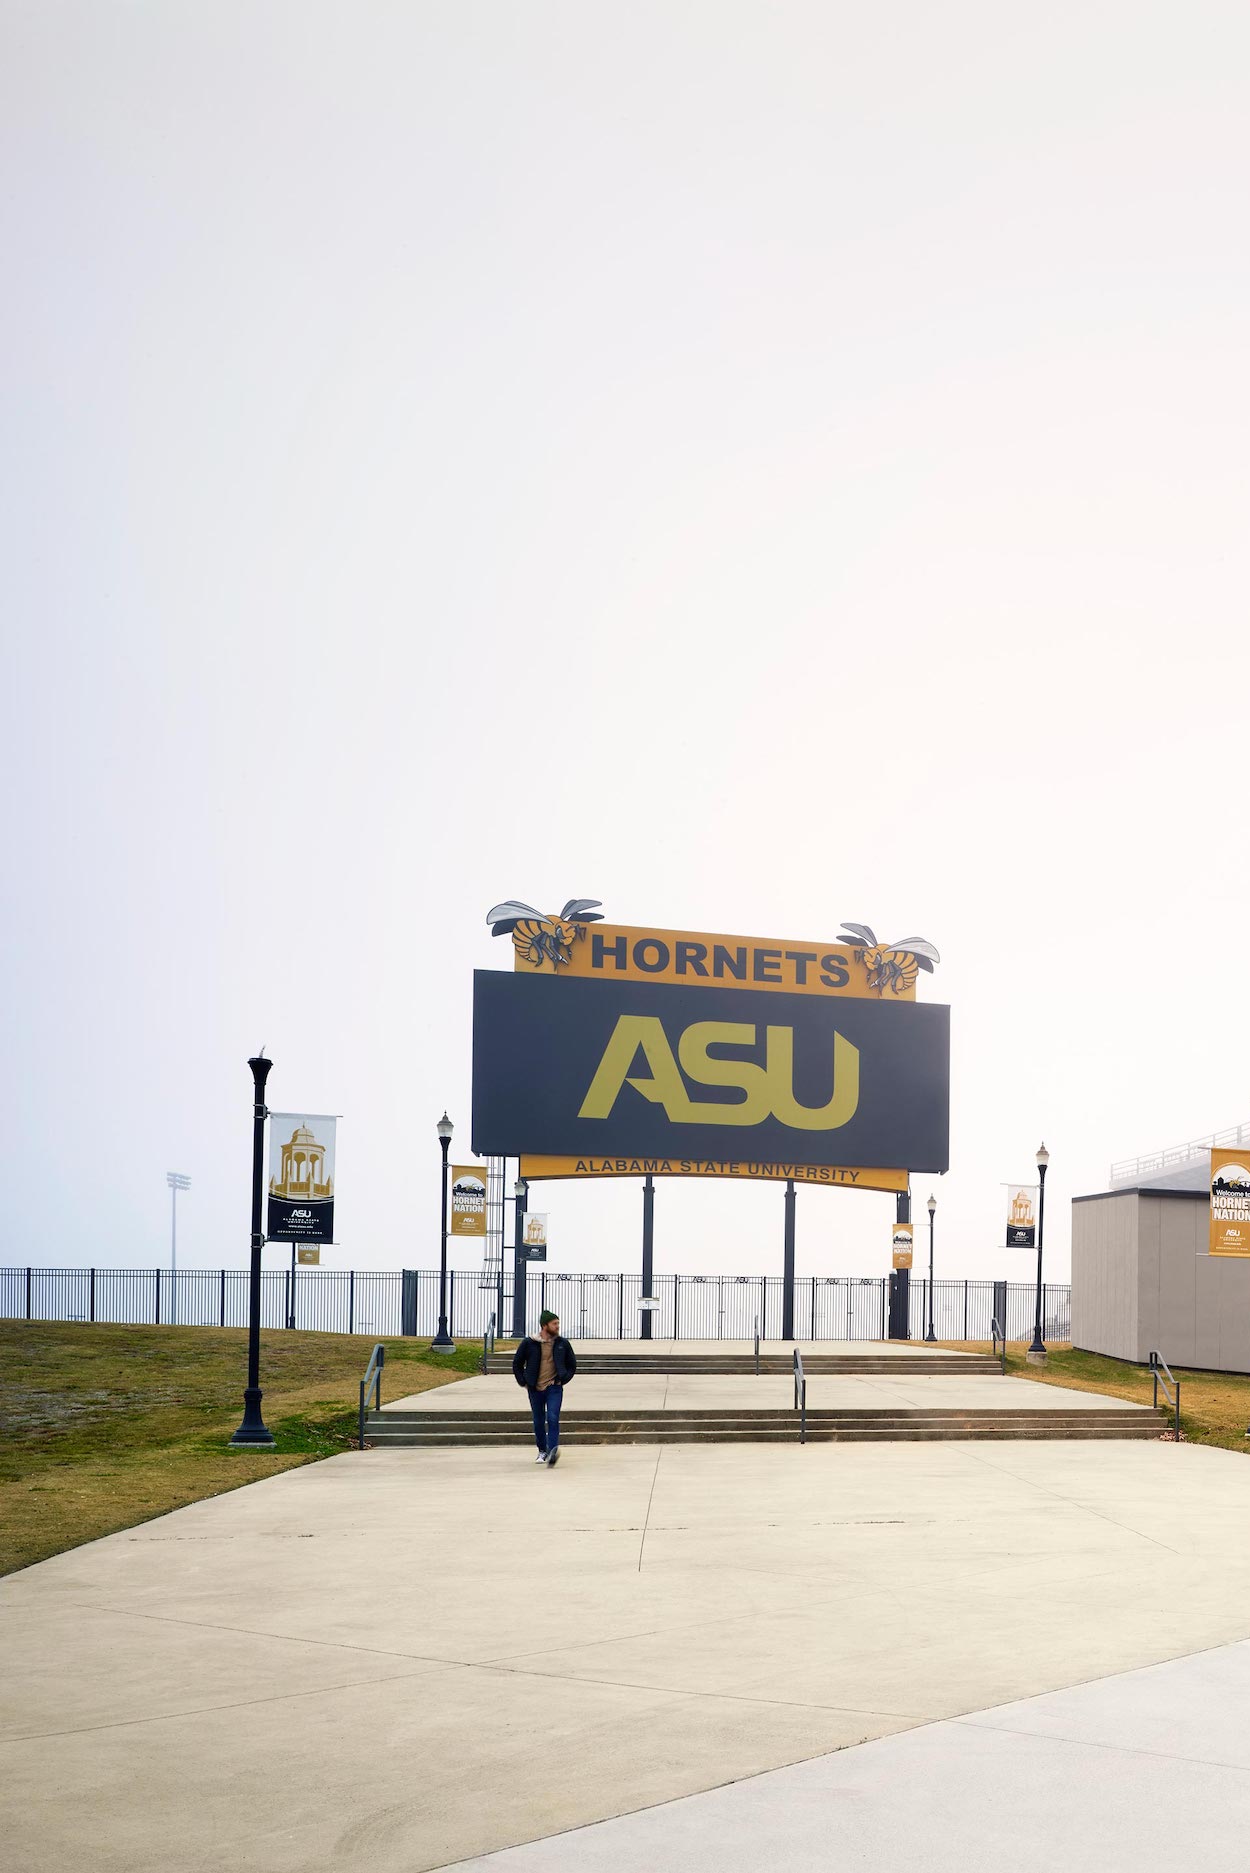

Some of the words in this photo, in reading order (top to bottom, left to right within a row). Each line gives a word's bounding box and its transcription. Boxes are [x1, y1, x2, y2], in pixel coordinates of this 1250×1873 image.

[590, 934, 850, 988] HORNETS
[577, 1014, 860, 1131] ASU
[575, 1159, 672, 1173] ALABAMA
[680, 1160, 740, 1174] STATE
[749, 1162, 861, 1183] UNIVERSITY
[1215, 1189, 1244, 1198] Welcome
[452, 1196, 485, 1205] HORNET
[454, 1203, 484, 1213] NATION
[291, 1209, 312, 1218] ASU
[1225, 1229, 1241, 1237] ASU
